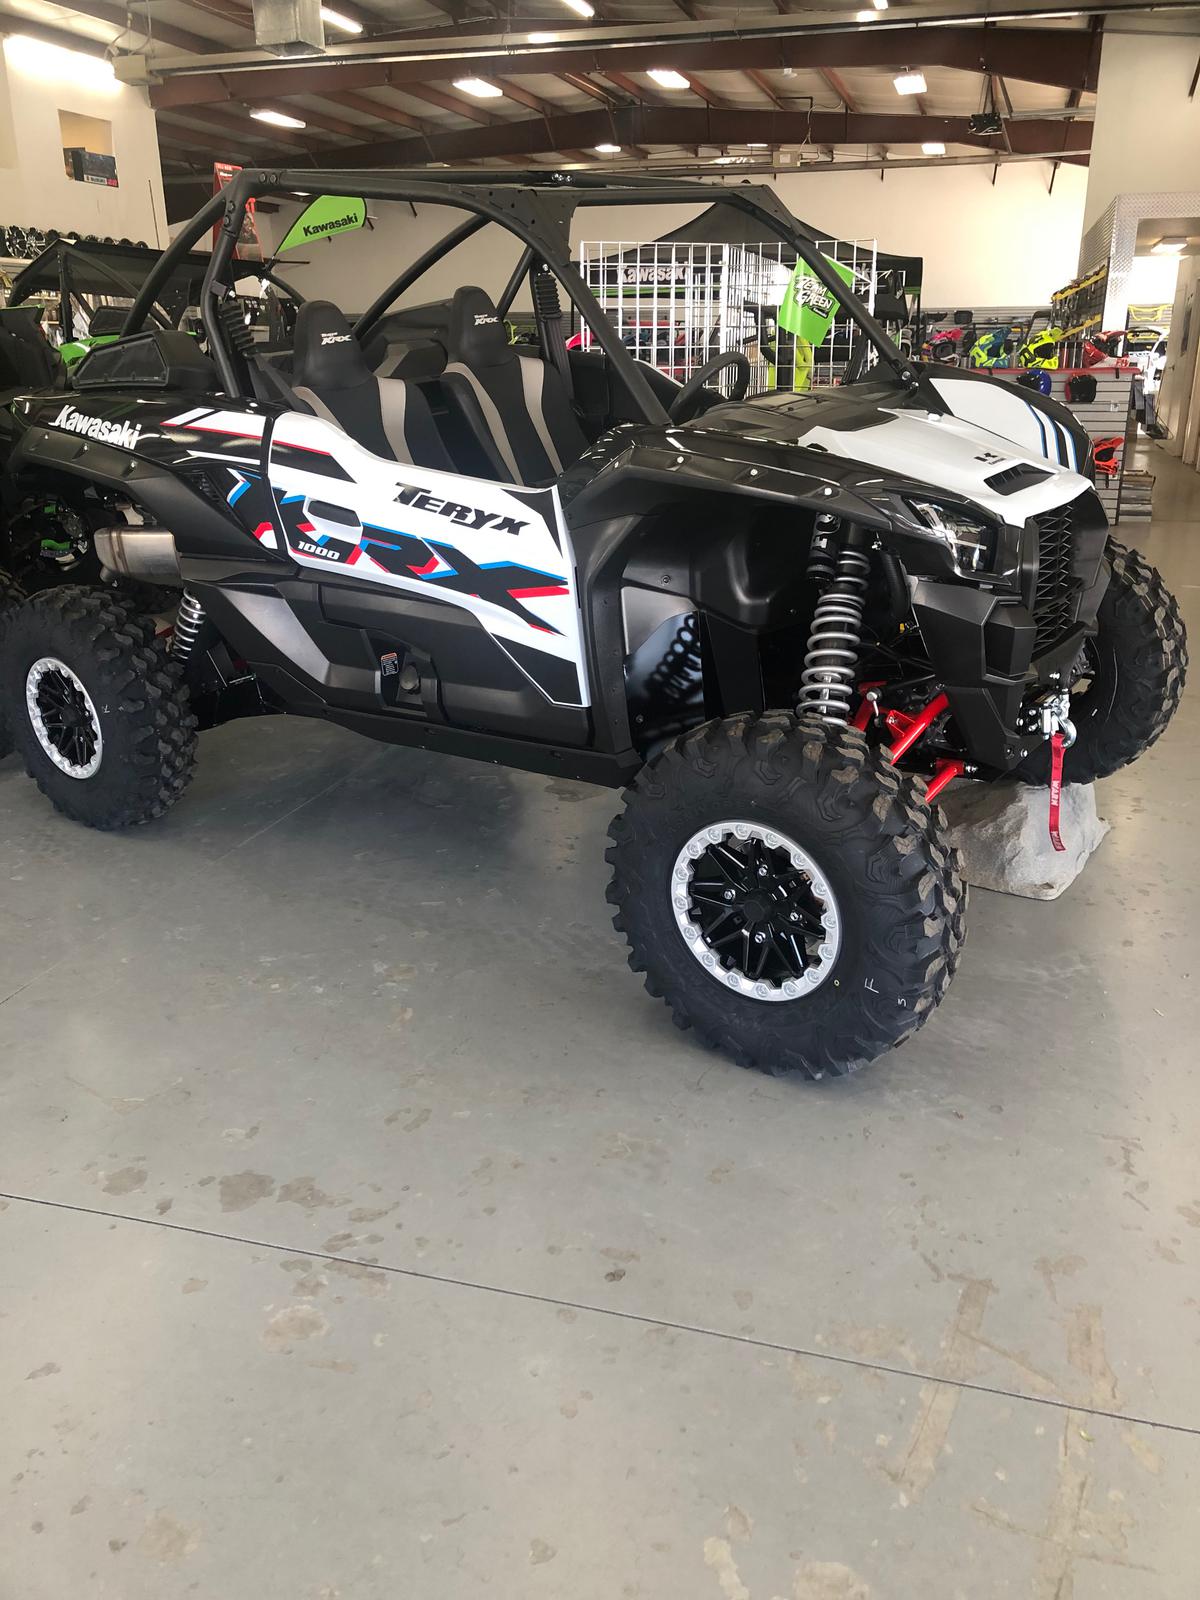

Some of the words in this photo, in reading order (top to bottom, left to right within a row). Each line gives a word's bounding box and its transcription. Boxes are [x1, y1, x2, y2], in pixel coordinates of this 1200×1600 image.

[303, 213, 358, 236] Kawasaki
[616, 261, 689, 284] Kawasaki
[795, 275, 828, 297] TEAM
[795, 290, 833, 310] GREEN
[49, 404, 142, 450] Kawasaki
[298, 540, 340, 561] 1000
[1051, 780, 1061, 806] WARN
